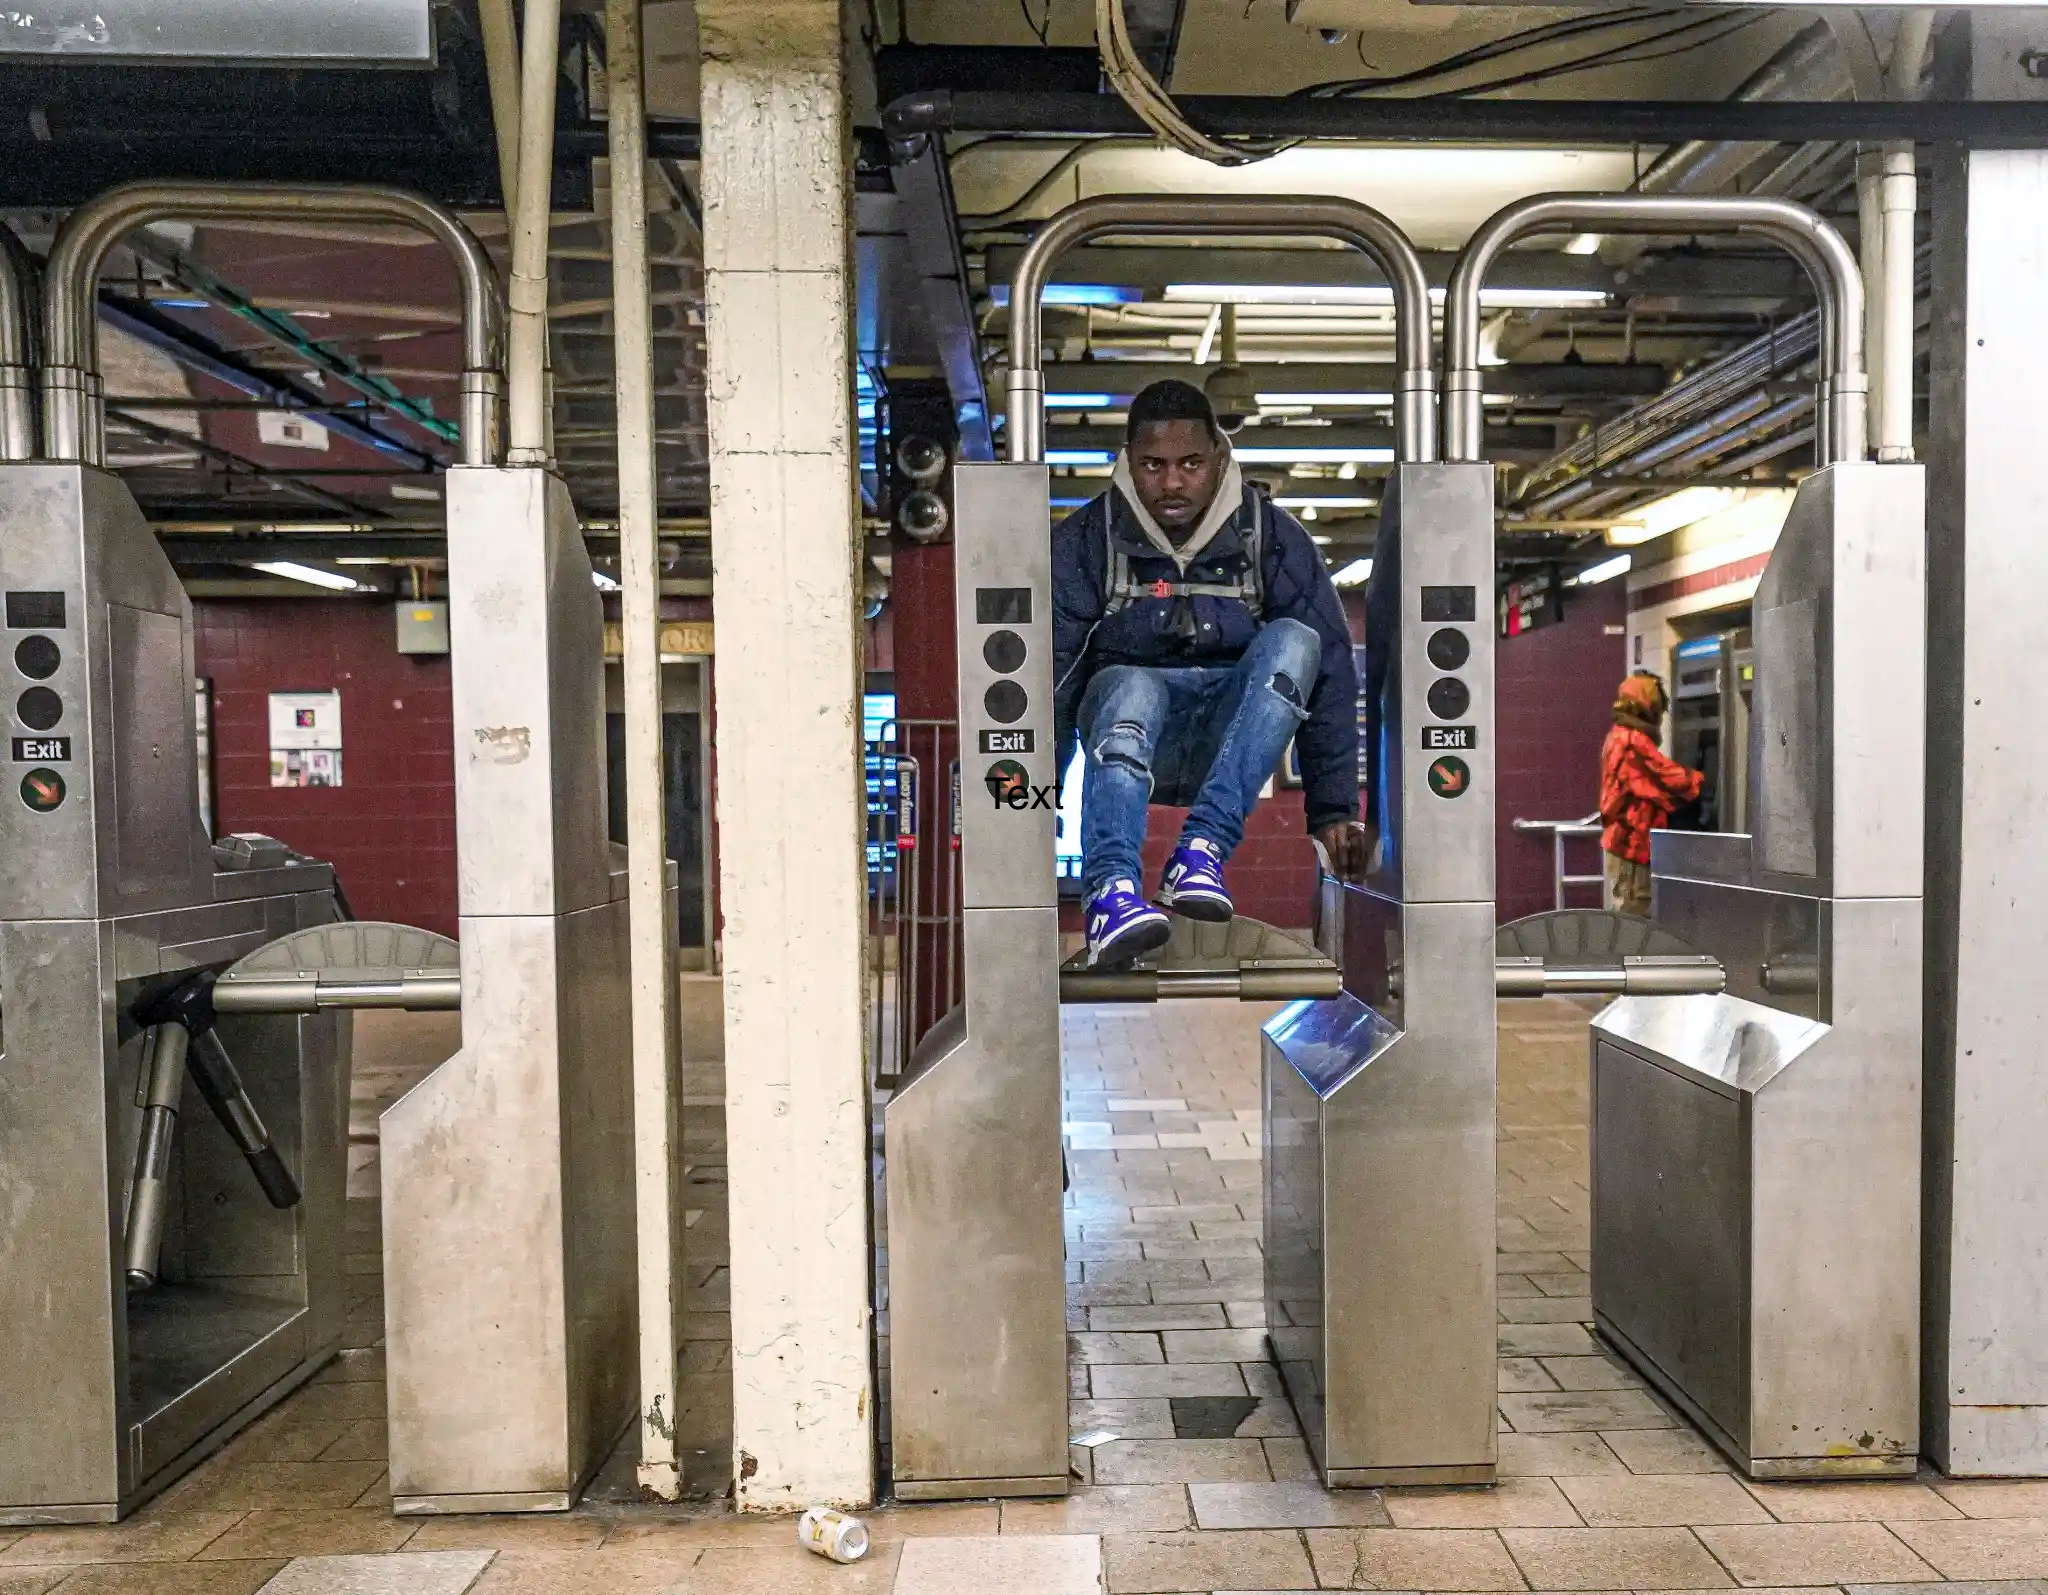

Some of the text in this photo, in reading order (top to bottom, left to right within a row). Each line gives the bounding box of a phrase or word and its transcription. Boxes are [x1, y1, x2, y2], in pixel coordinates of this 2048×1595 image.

[988, 732, 1025, 751] Exit
[1431, 729, 1466, 747] Exit
[23, 740, 63, 759] Exit
[900, 771, 914, 835] amny.com
